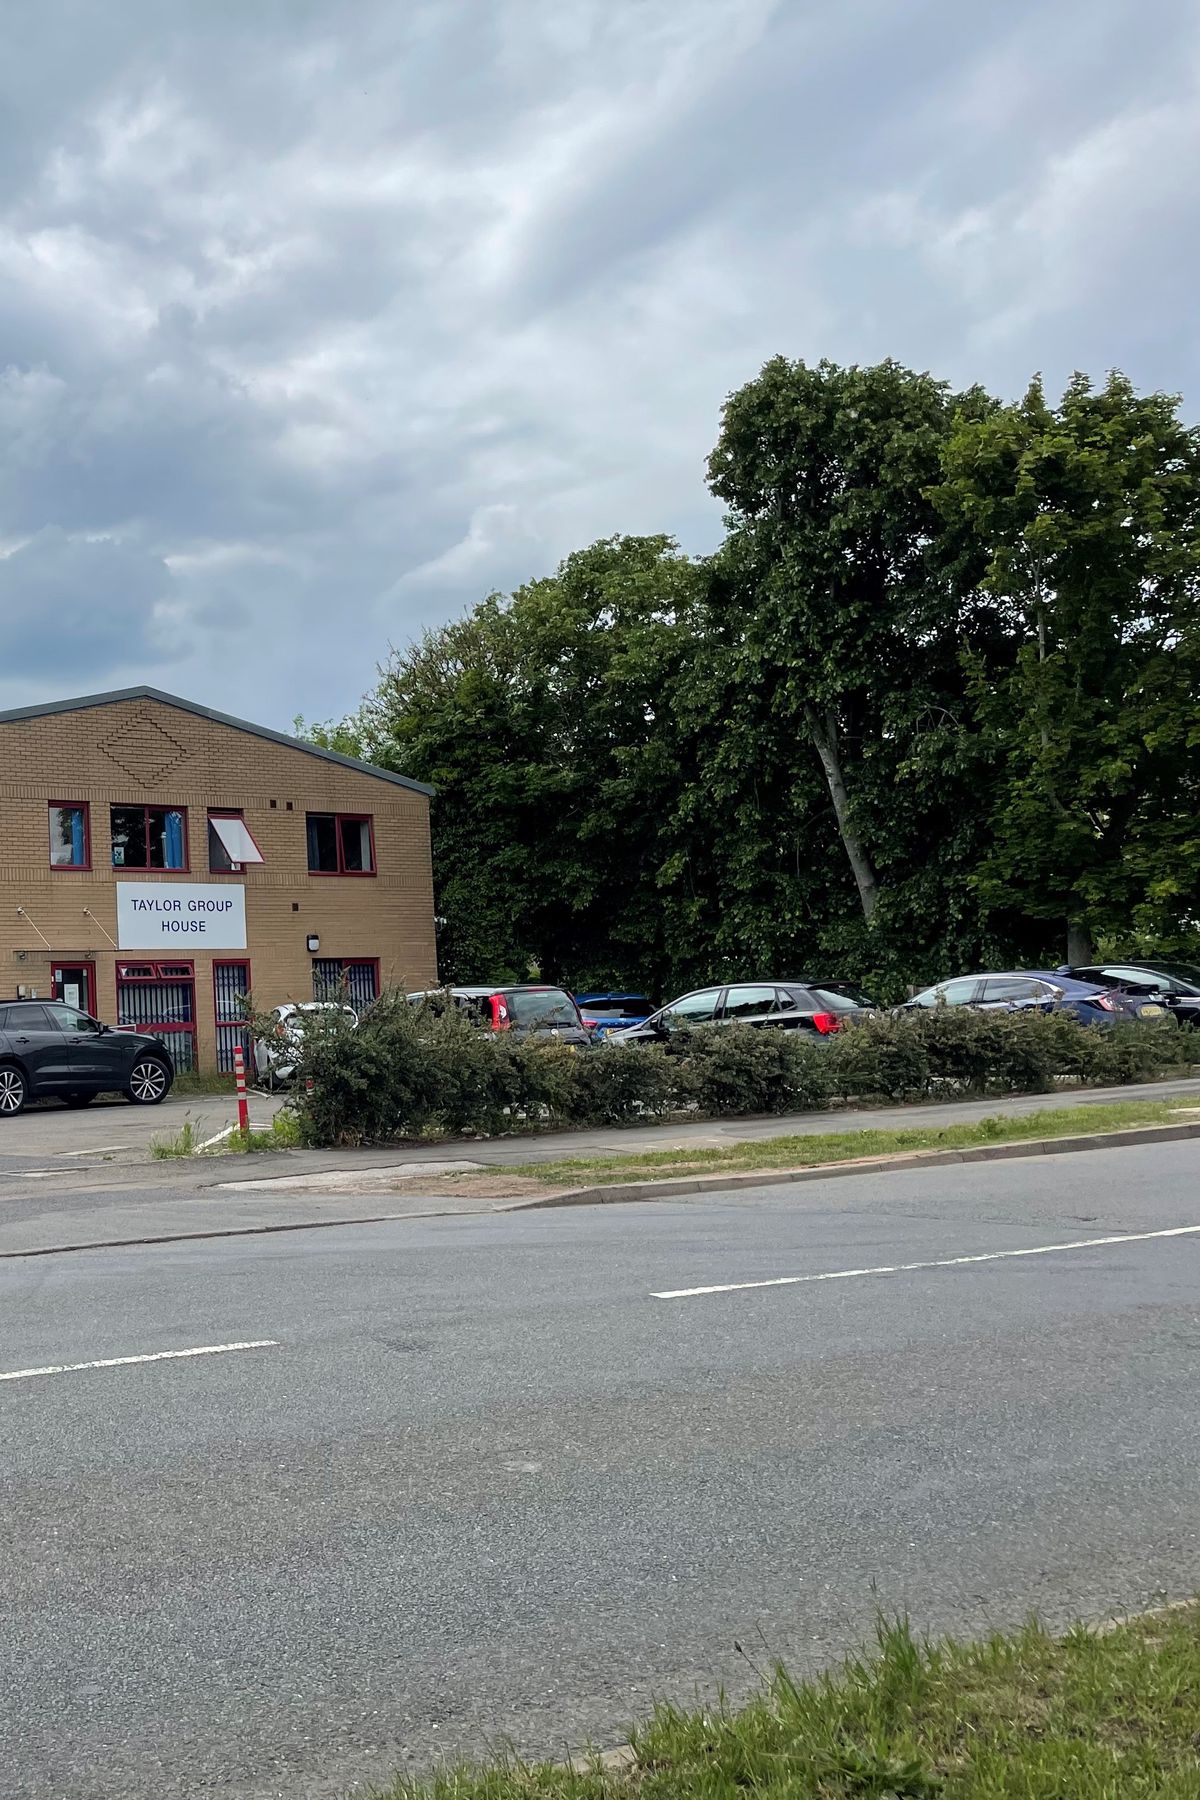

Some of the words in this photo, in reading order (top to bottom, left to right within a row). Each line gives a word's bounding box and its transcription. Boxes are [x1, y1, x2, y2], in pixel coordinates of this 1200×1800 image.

[131, 899, 182, 912] TAYLOR
[187, 900, 233, 912] GROUP
[161, 920, 206, 932] HOUSE
